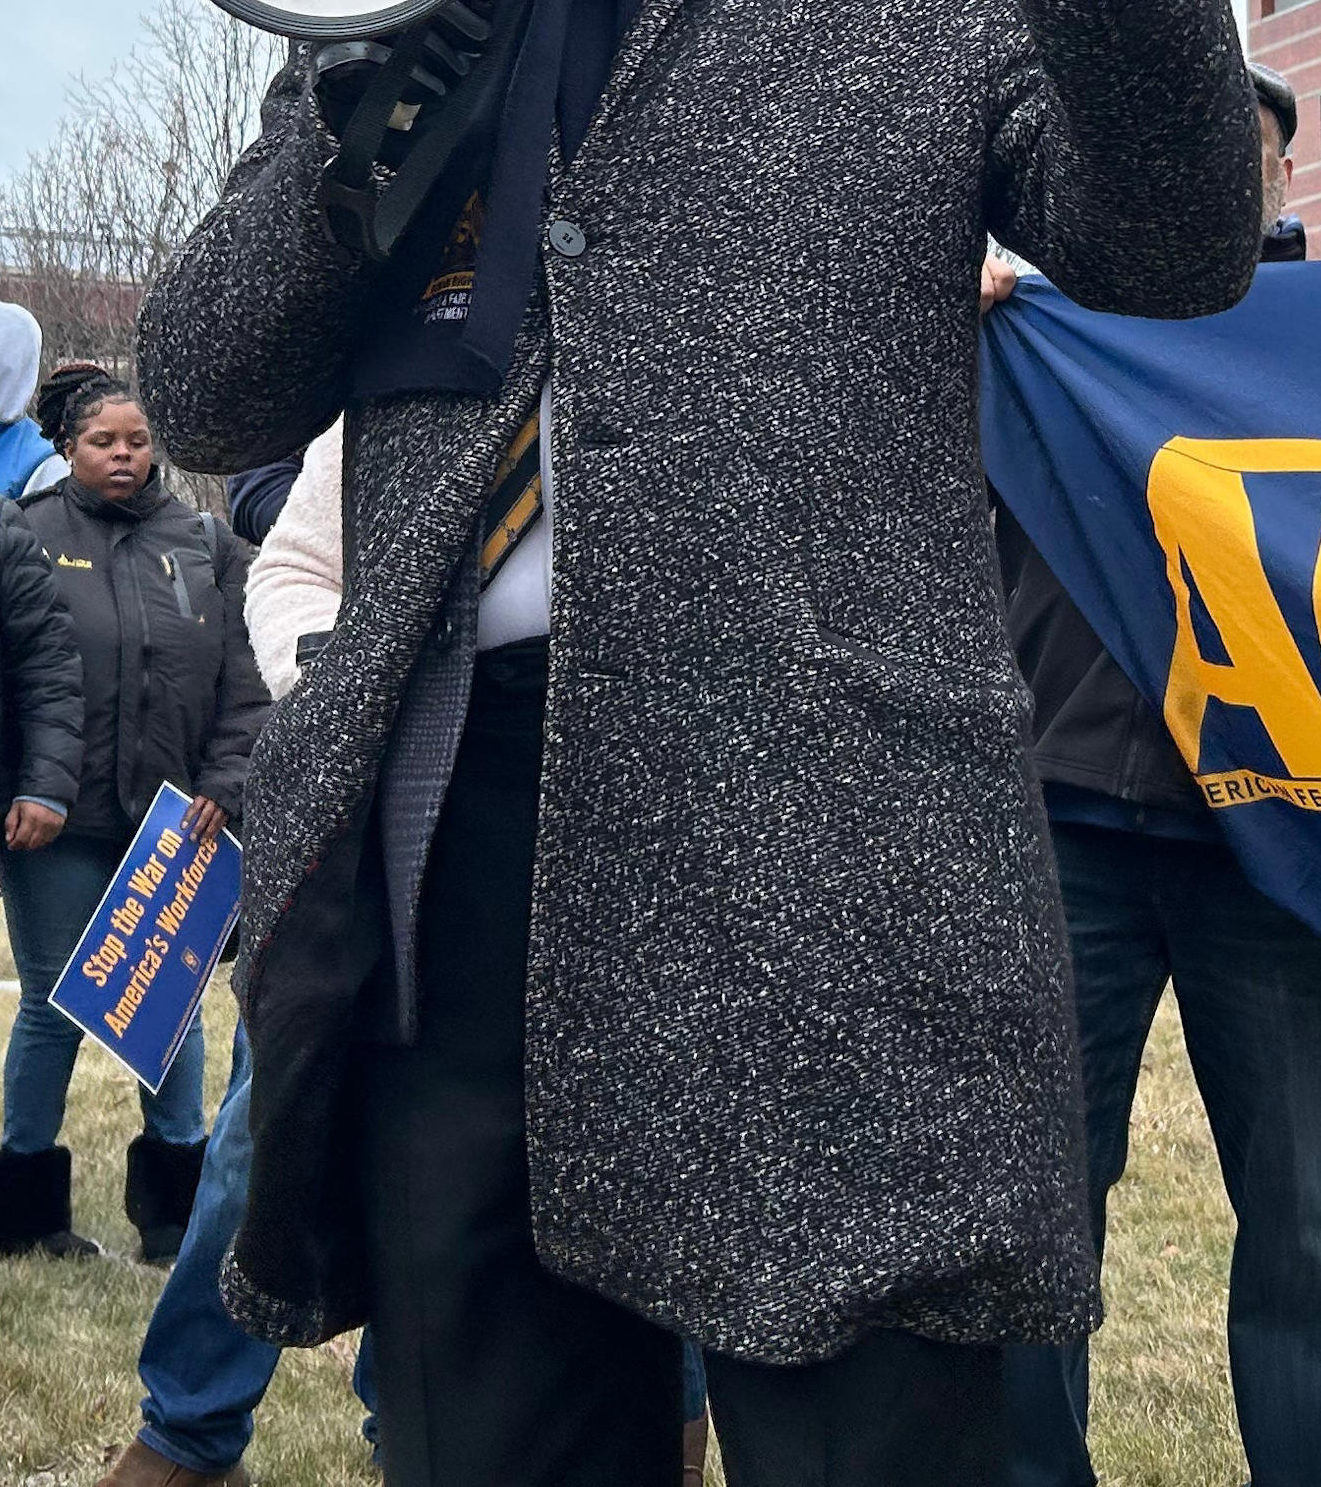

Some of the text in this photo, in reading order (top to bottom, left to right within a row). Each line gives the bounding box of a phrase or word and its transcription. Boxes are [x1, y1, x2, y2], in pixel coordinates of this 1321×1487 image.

[82, 828, 184, 988] Stop the War on
[103, 934, 170, 1039] America's
[155, 839, 218, 936] Workforce
